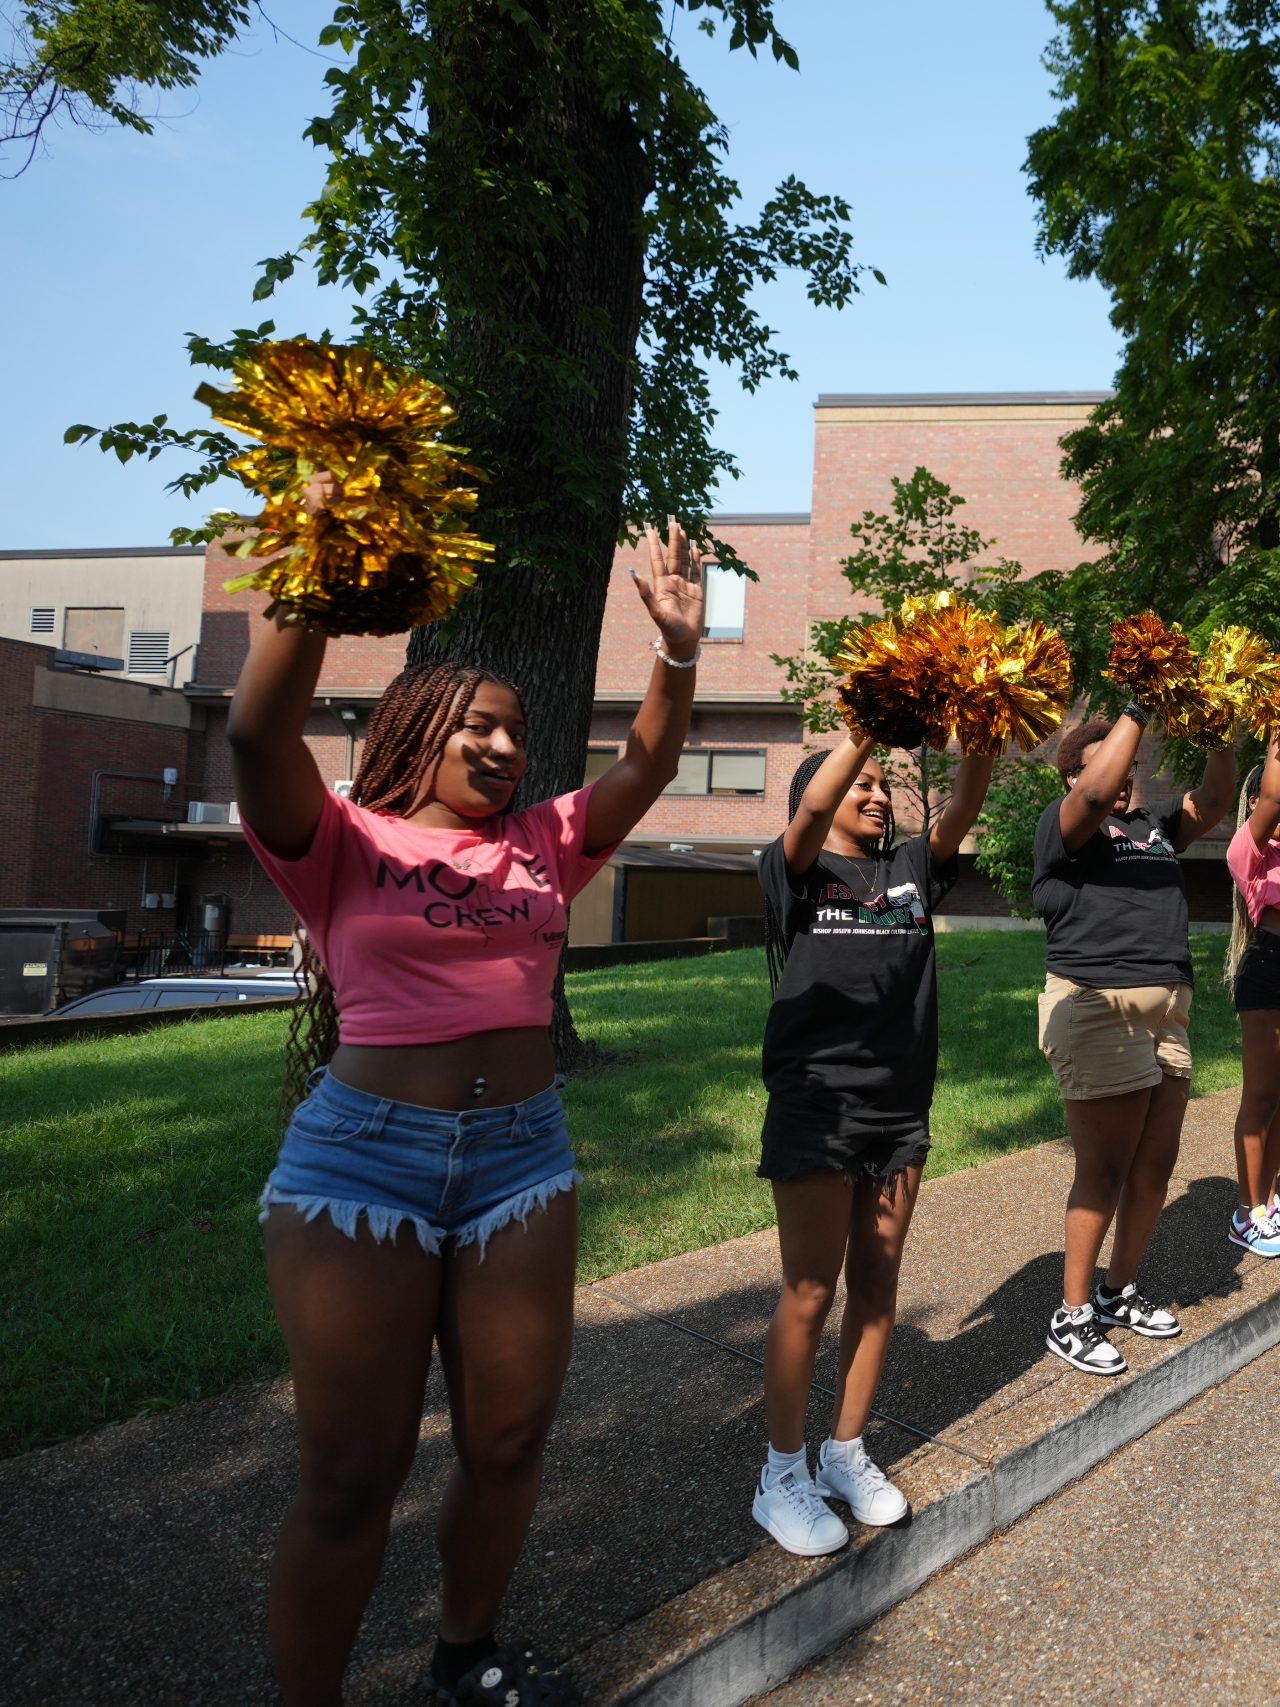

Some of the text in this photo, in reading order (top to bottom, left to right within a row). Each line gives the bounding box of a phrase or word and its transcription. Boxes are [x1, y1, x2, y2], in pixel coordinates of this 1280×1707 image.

[376, 853, 551, 900] MOE
[424, 899, 529, 928] CREW
[816, 908, 853, 922] THE
